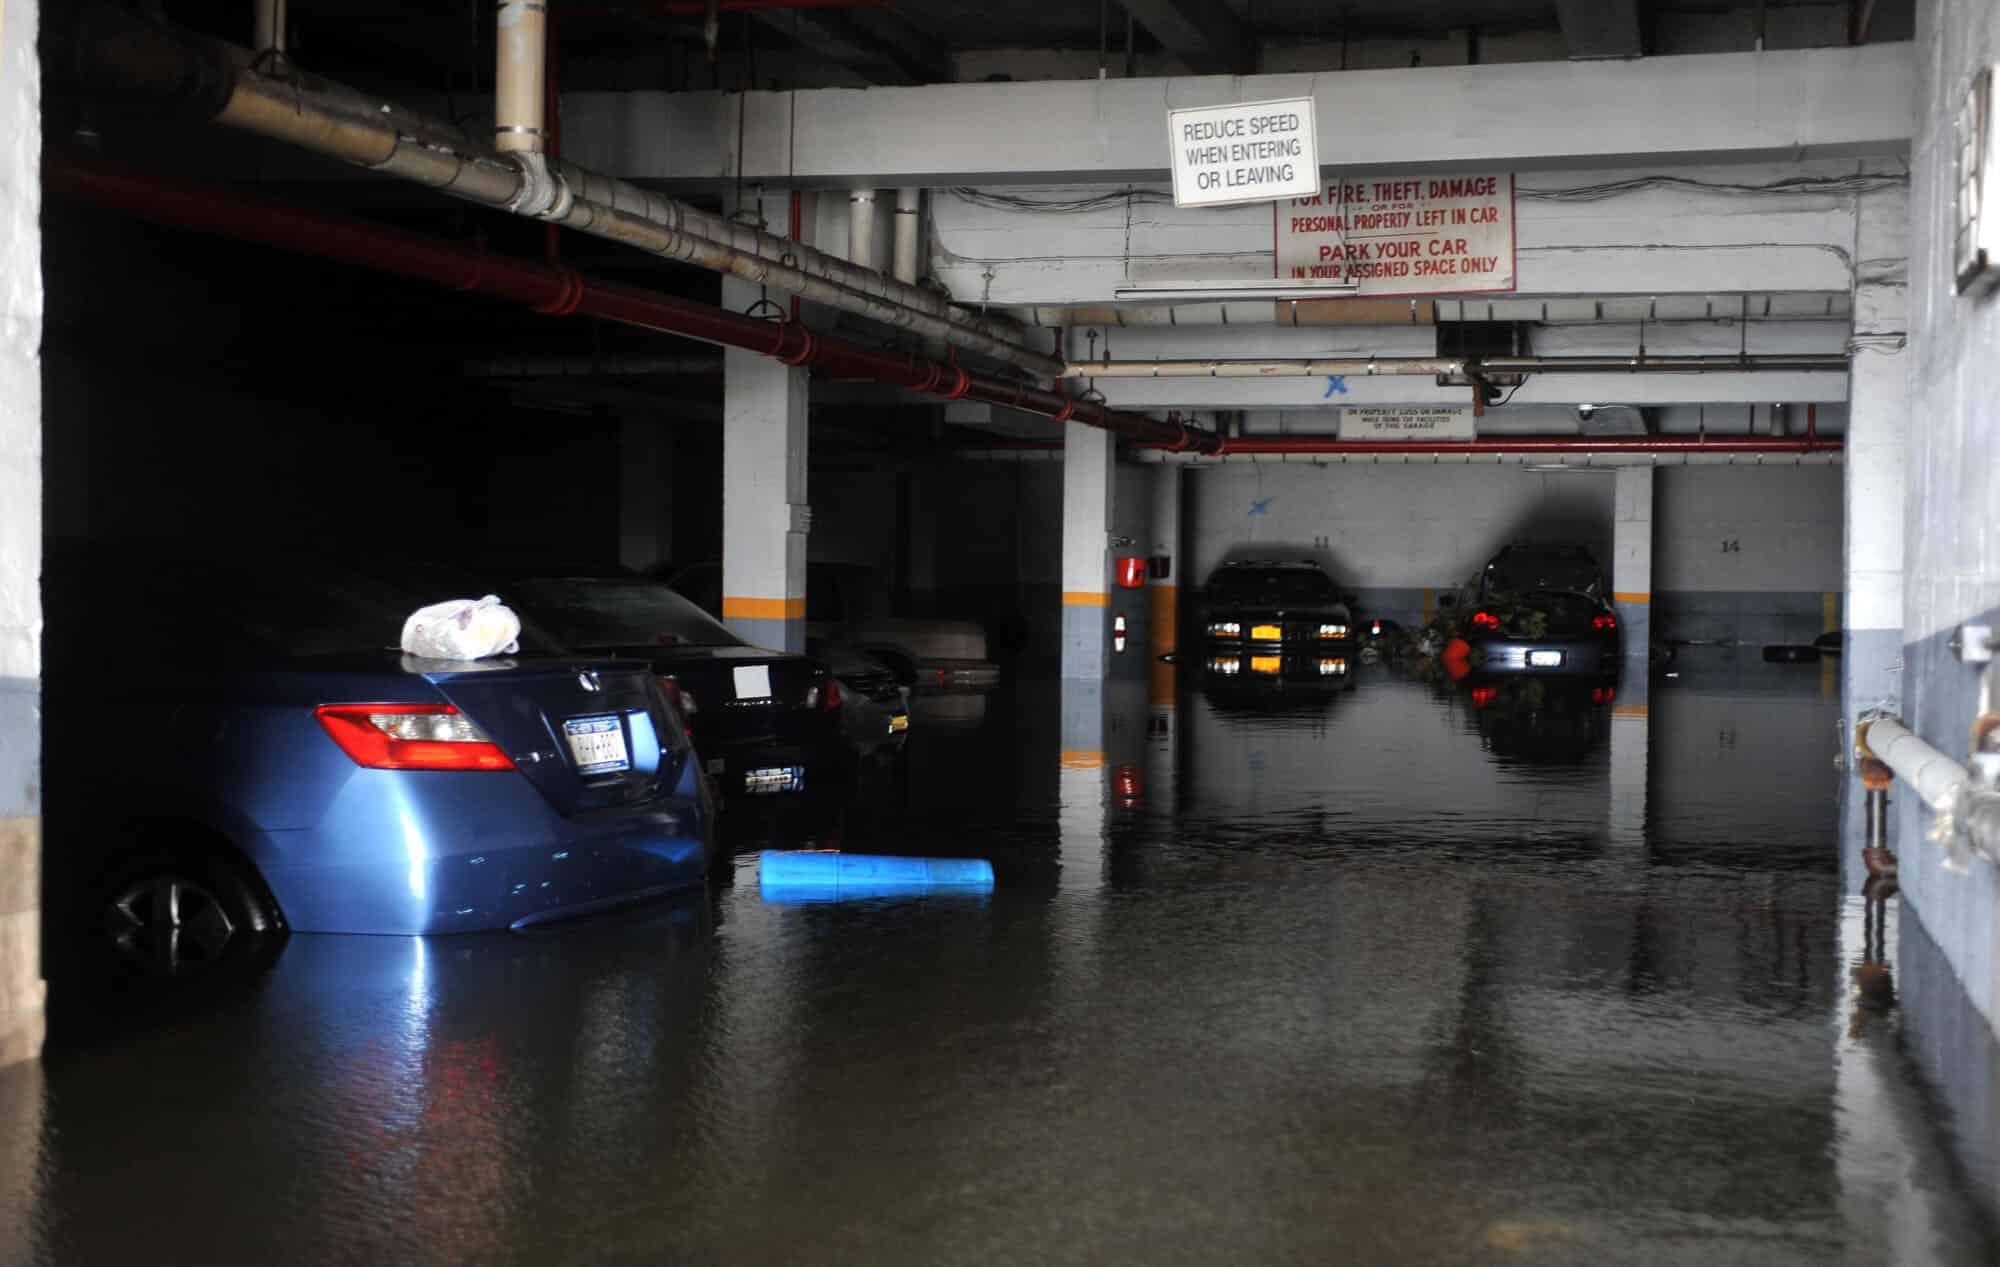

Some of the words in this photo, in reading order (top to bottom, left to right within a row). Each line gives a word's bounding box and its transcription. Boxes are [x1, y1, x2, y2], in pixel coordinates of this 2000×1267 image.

[1184, 119, 1245, 141] REDUCE
[1249, 114, 1299, 135] SPEED
[1186, 145, 1227, 166] WHEN
[1232, 138, 1301, 161] ENTERING
[1198, 171, 1221, 190] OR
[1226, 164, 1294, 187] LEAVING
[1429, 177, 1497, 199] DAMAGE
[1292, 215, 1352, 233] PERSONAL
[1354, 211, 1410, 230] PROPERTY
[1416, 209, 1446, 226] LEFT
[1451, 208, 1466, 224] IN
[1471, 206, 1498, 224] CAR
[1319, 243, 1370, 261] PARK
[1376, 240, 1421, 259] YOUR
[1429, 238, 1467, 256] CAR
[1291, 265, 1305, 278] IN
[1311, 265, 1340, 278] YOUR
[1346, 261, 1409, 278] ASSIGNED
[1414, 258, 1457, 276] SPACE
[1461, 255, 1498, 273] ONLY
